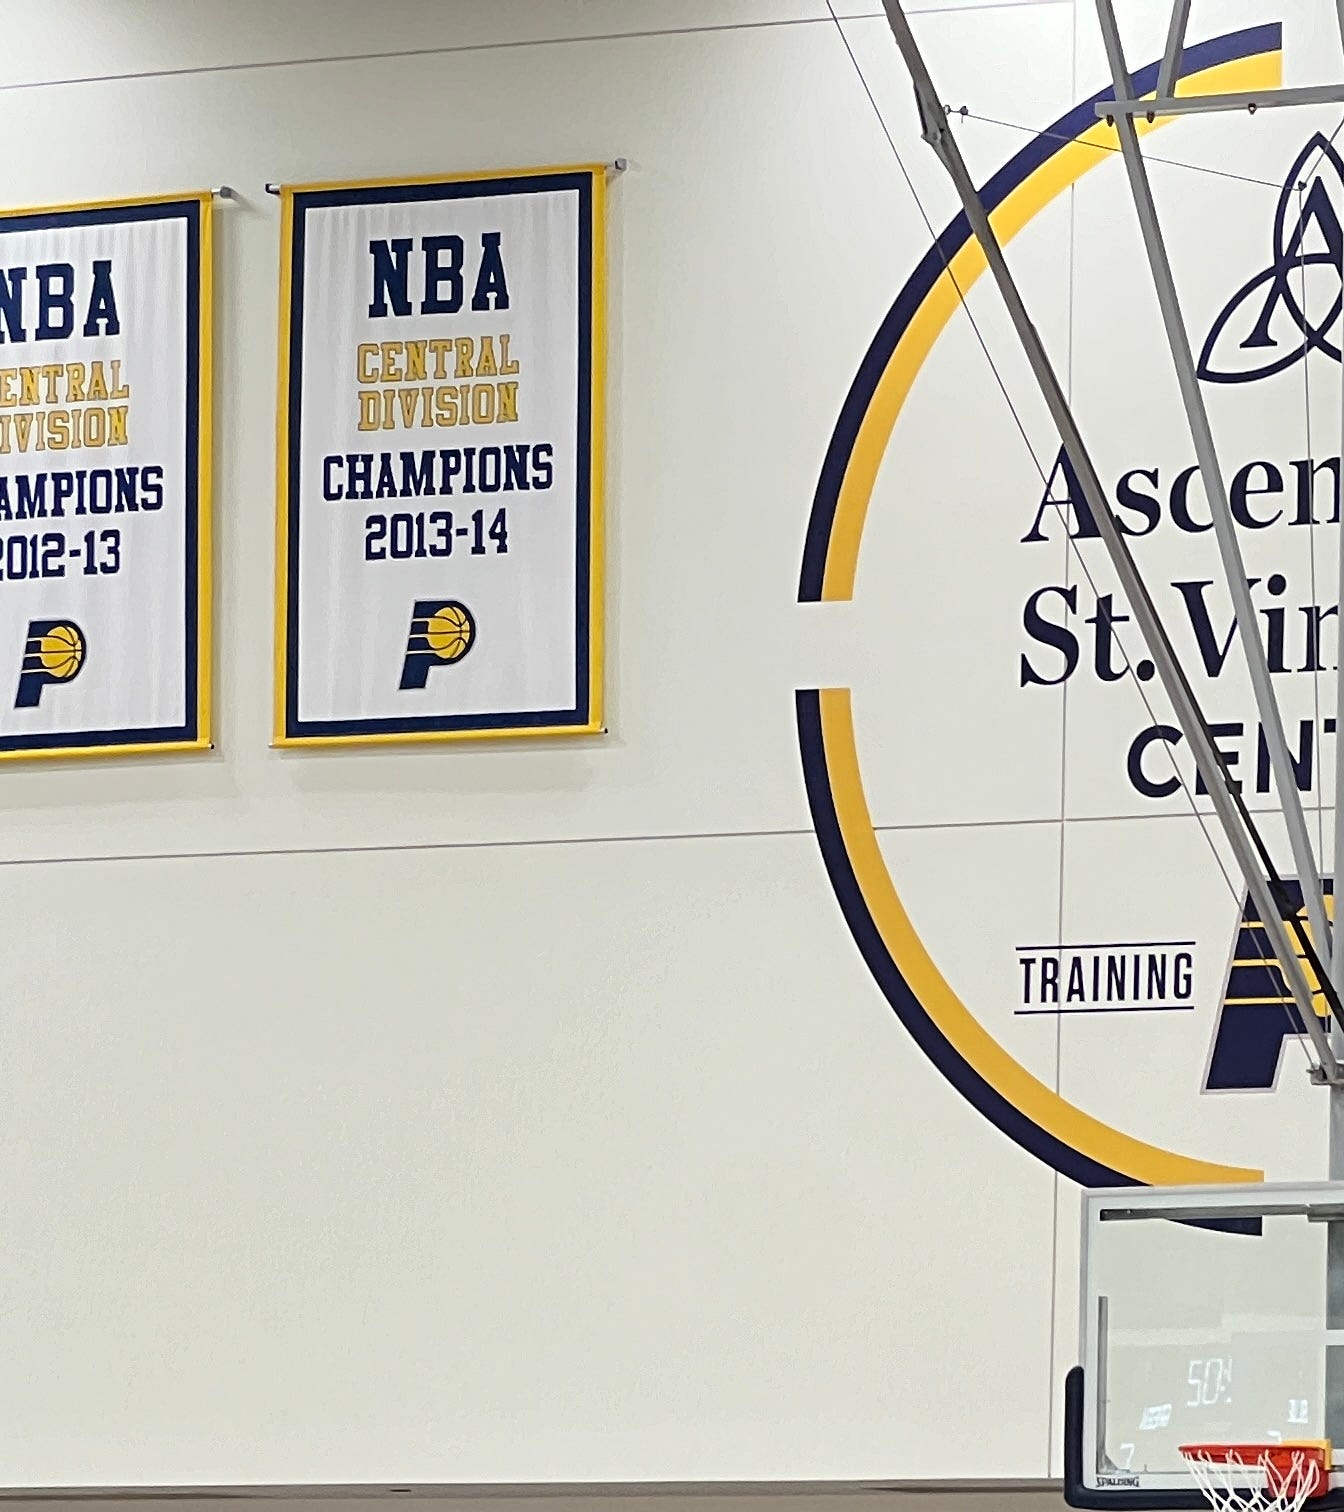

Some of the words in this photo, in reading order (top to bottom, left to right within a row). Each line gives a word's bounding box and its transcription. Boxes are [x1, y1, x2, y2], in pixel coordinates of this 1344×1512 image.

[368, 232, 510, 318] NBA
[0, 260, 120, 344] NBA
[0, 360, 129, 407] ENTRAL
[356, 335, 519, 384] CENTRAL
[0, 406, 128, 454] IVISION
[357, 381, 519, 432] DIVISION
[0, 466, 163, 521] AMPIONS
[322, 443, 554, 501] CHAMPIONS
[0, 529, 120, 580] 012-13
[364, 507, 510, 560] 2013-14
[1019, 949, 1193, 1003] TRAINING
[1096, 1477, 1140, 1488] SPALDING
